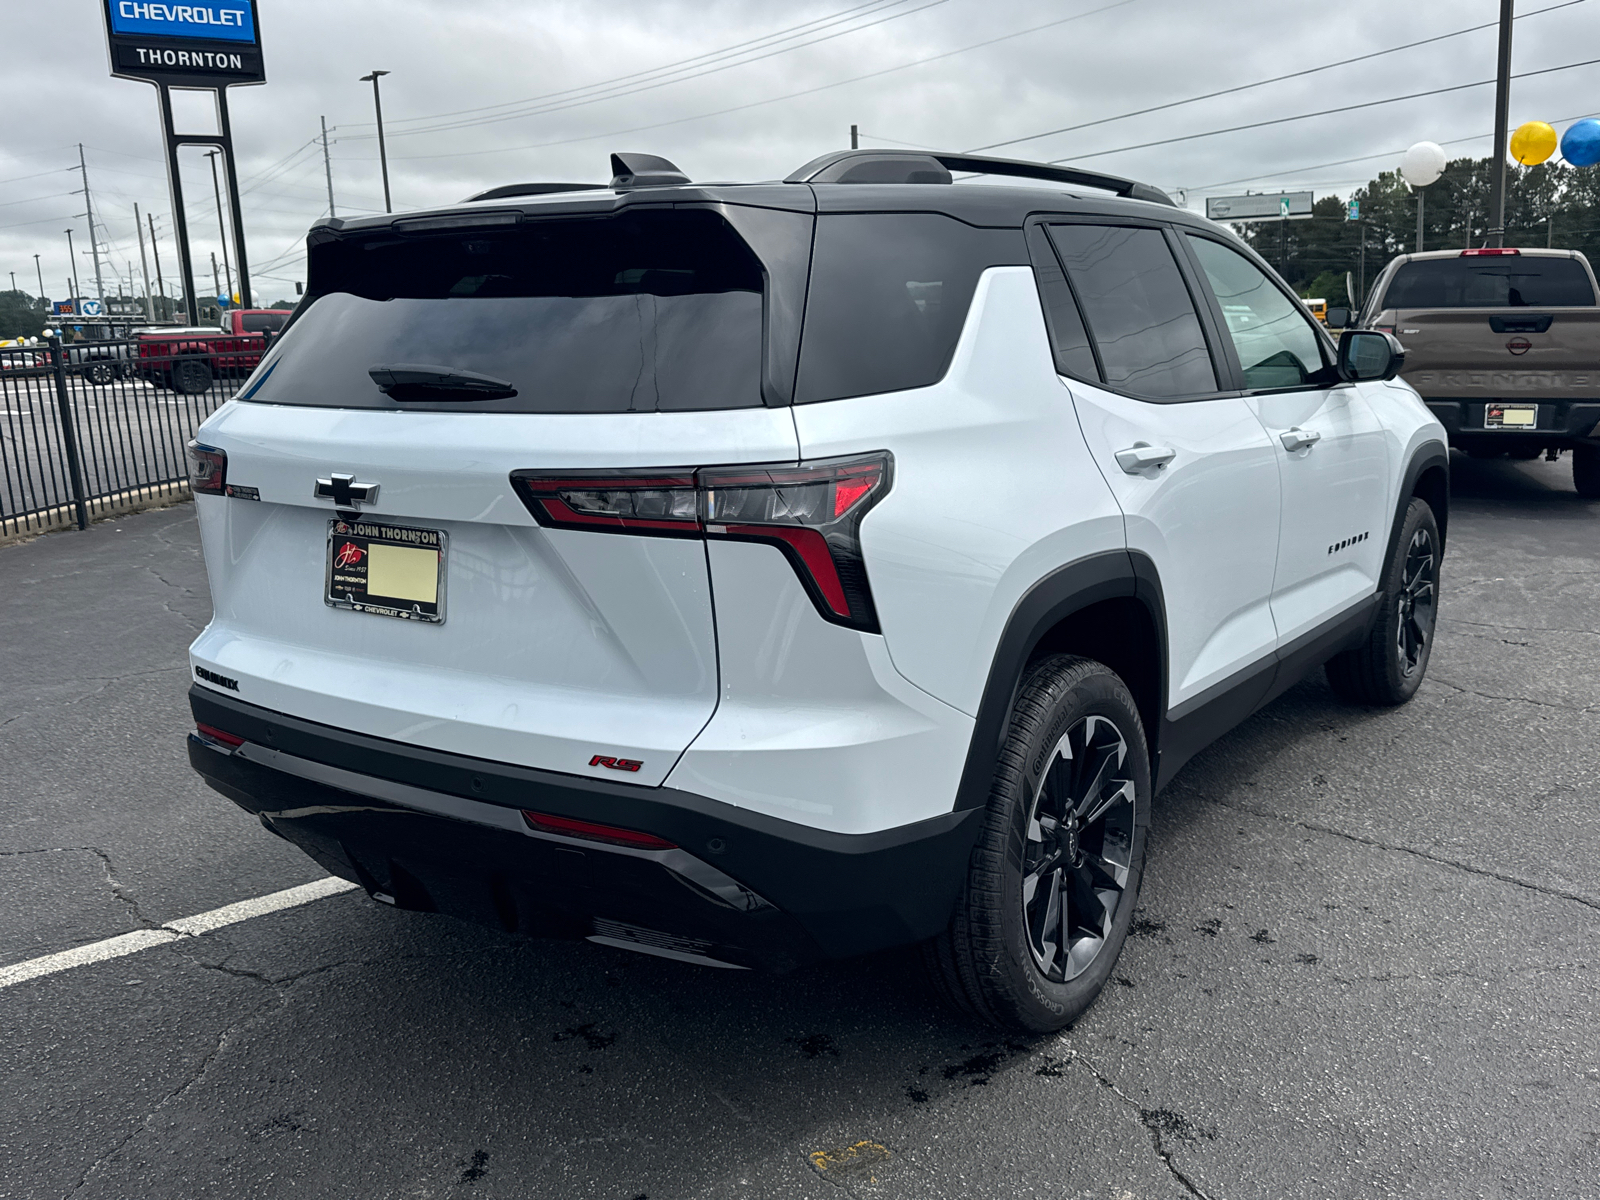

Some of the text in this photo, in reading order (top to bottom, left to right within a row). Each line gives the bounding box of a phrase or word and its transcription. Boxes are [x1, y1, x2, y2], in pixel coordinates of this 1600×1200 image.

[119, 1, 245, 27] CHEVROLET
[136, 48, 242, 69] THORNTON
[353, 523, 437, 545] JOHN THORNTON
[334, 574, 345, 582] JOHN
[364, 605, 398, 617] CHEVROLET
[1032, 705, 1070, 776] Continental
[588, 754, 644, 772] RS
